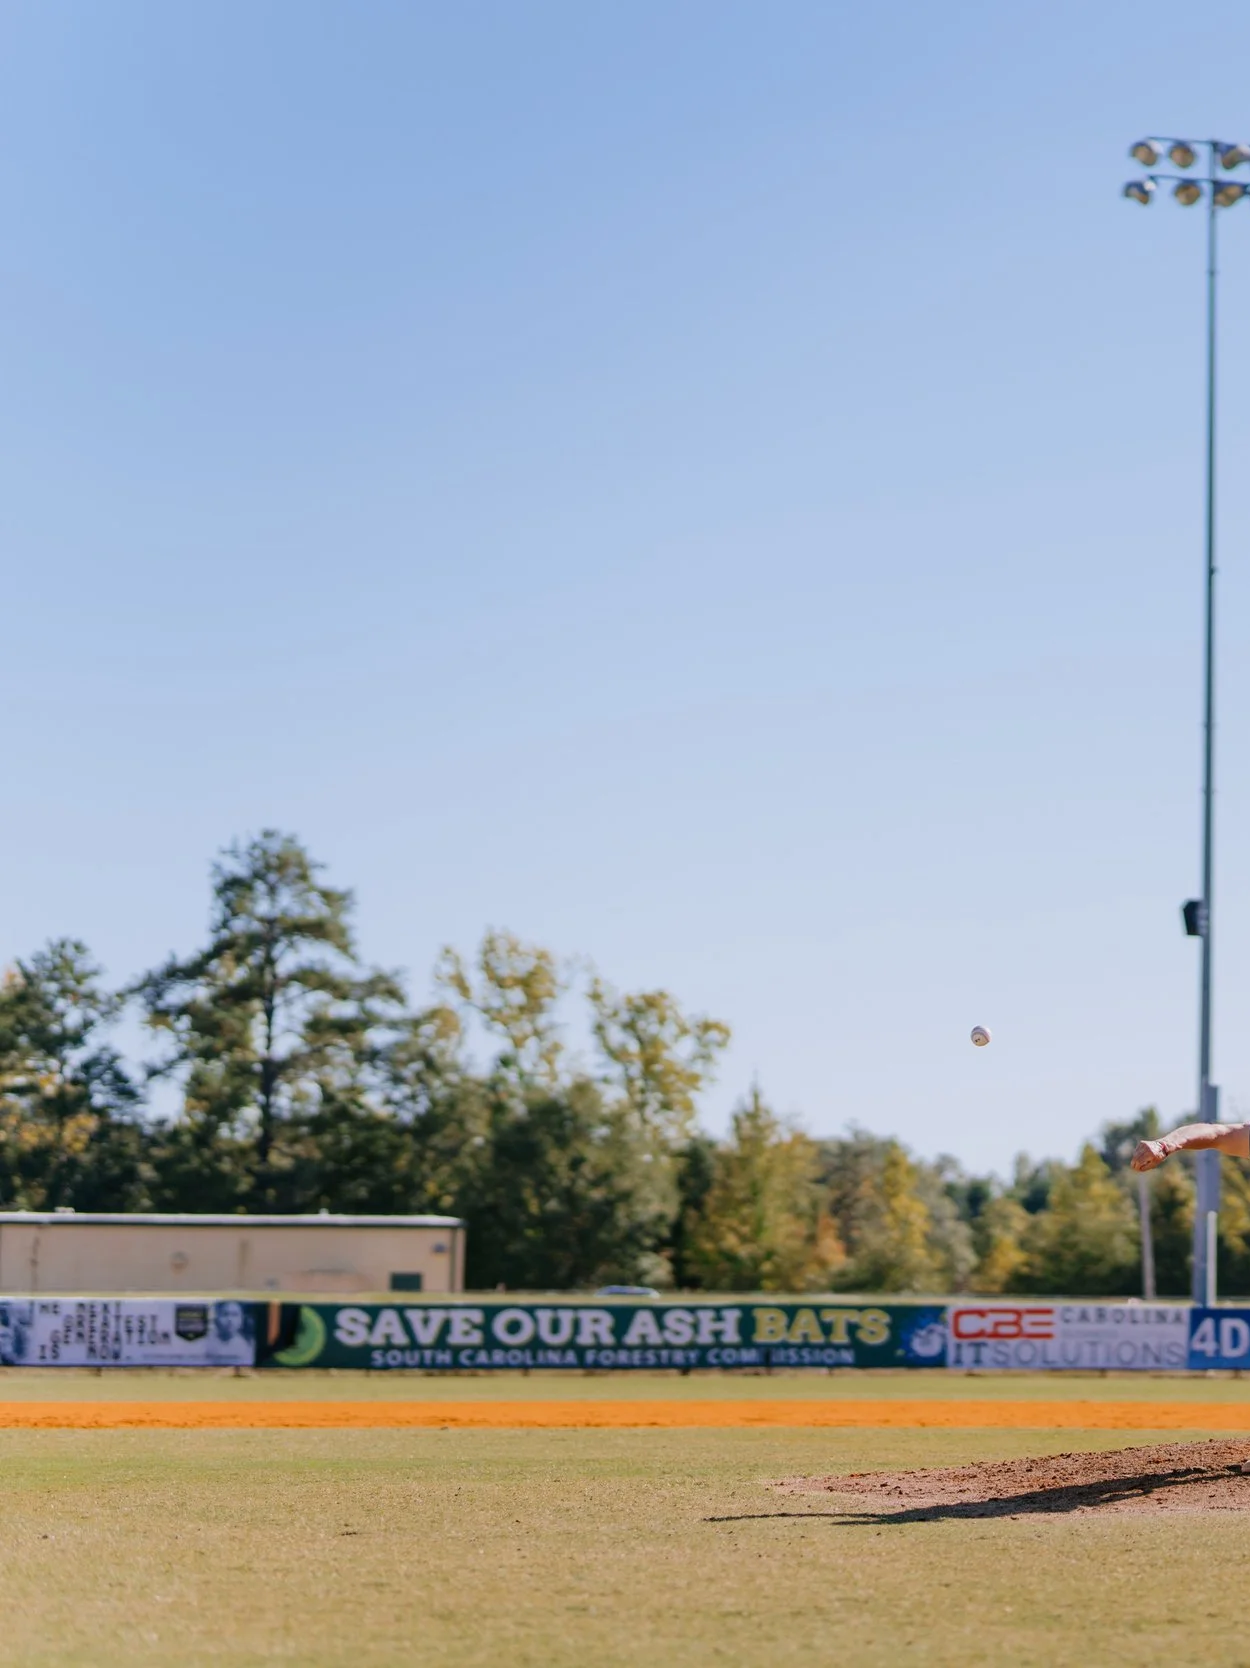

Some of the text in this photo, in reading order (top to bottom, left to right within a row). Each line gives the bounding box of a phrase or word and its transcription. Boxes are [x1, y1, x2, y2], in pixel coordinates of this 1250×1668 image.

[334, 1307, 891, 1346] SAVE OUR ASH BATS
[953, 1308, 1055, 1340] CBE
[1190, 1318, 1250, 1358] 4D
[371, 1350, 450, 1366] SOUTH
[458, 1349, 579, 1366] CAROLINA
[586, 1348, 698, 1365] FORESTRY
